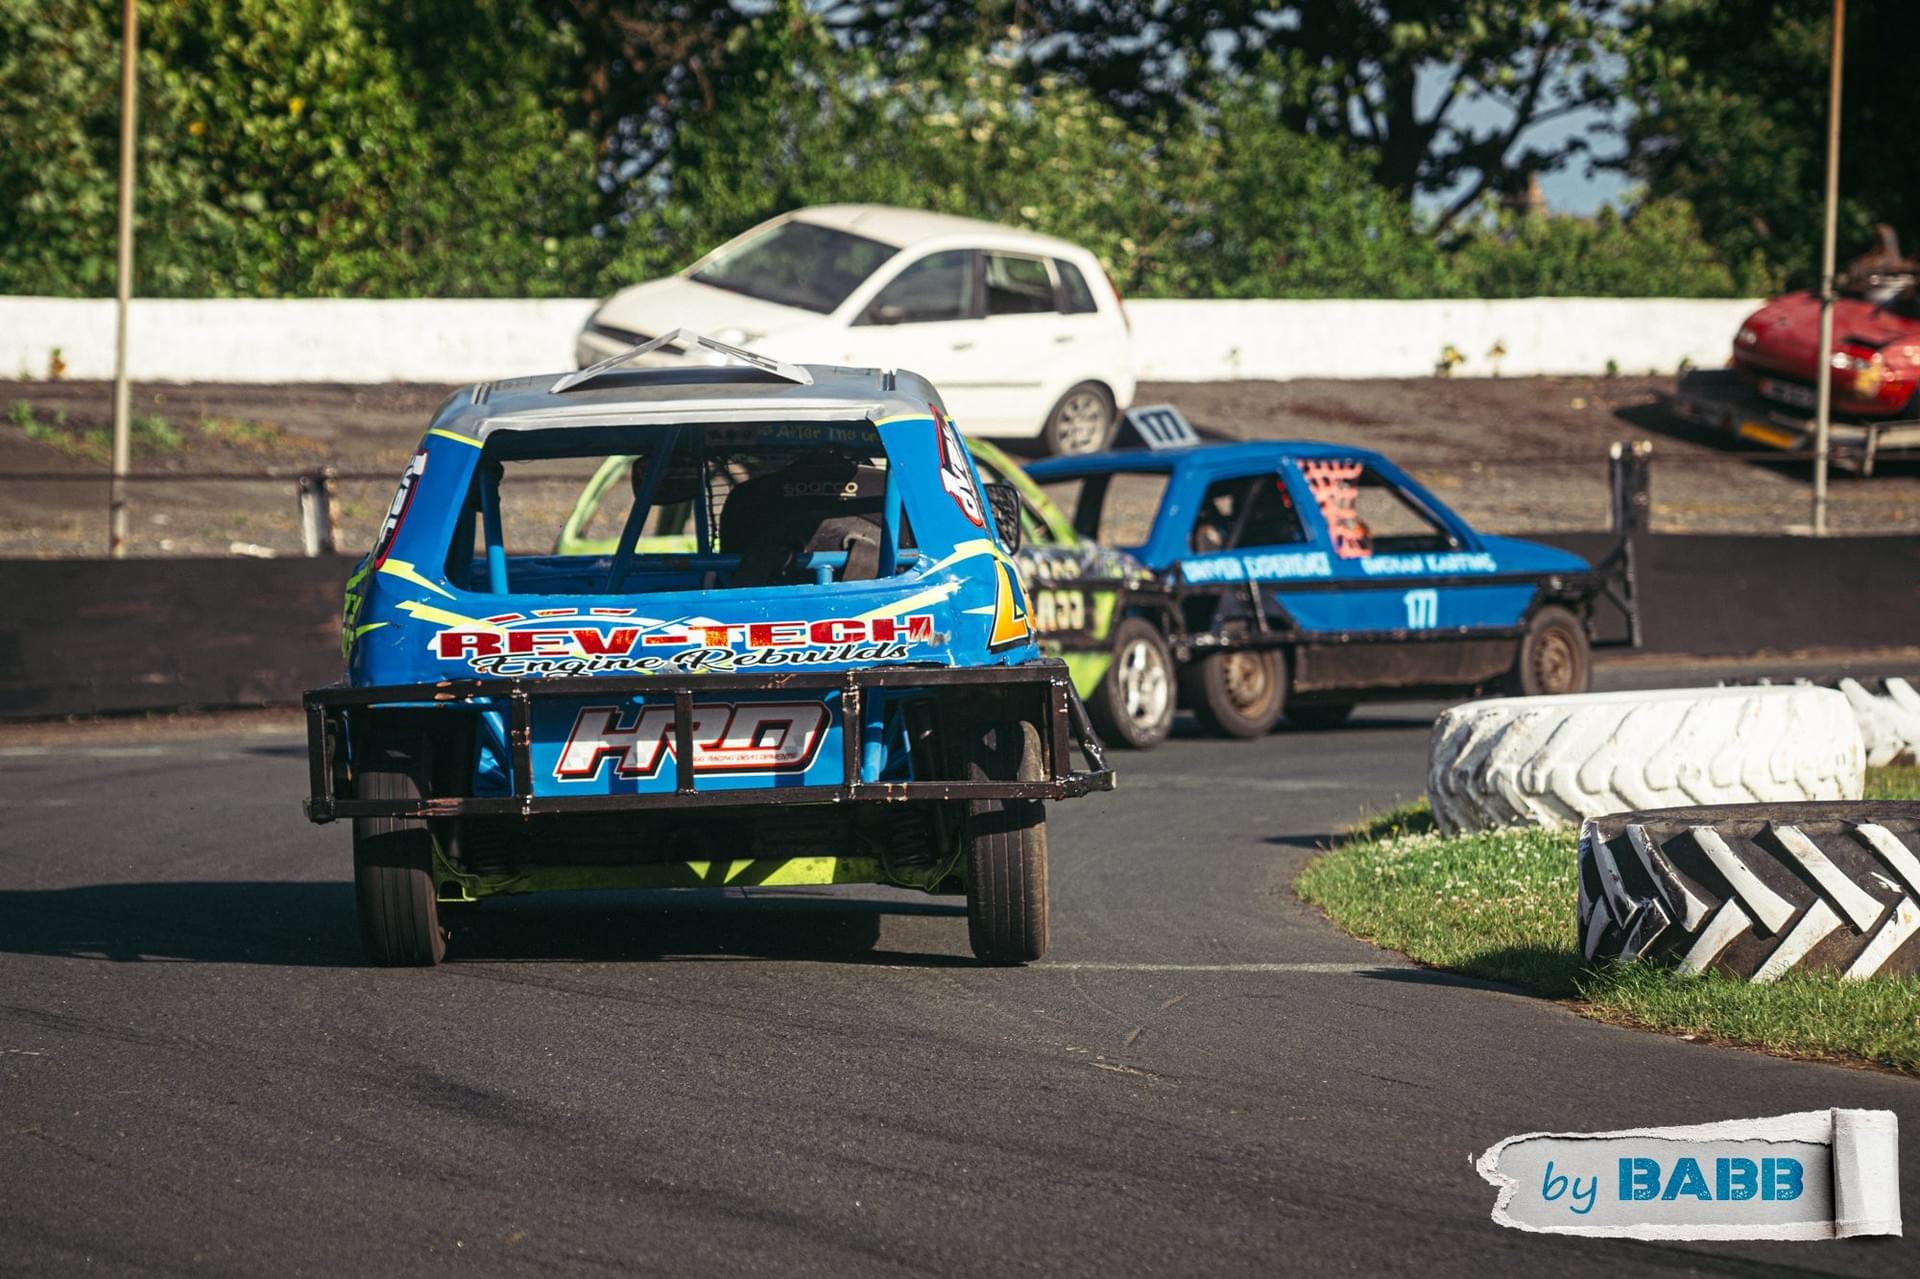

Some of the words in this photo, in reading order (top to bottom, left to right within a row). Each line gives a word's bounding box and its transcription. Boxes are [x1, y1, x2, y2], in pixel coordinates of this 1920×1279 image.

[784, 481, 859, 497] sparco
[436, 615, 934, 661] REV-TECH
[470, 649, 674, 678] Engine
[674, 642, 912, 674] Rebuilds
[555, 700, 832, 782] HRD
